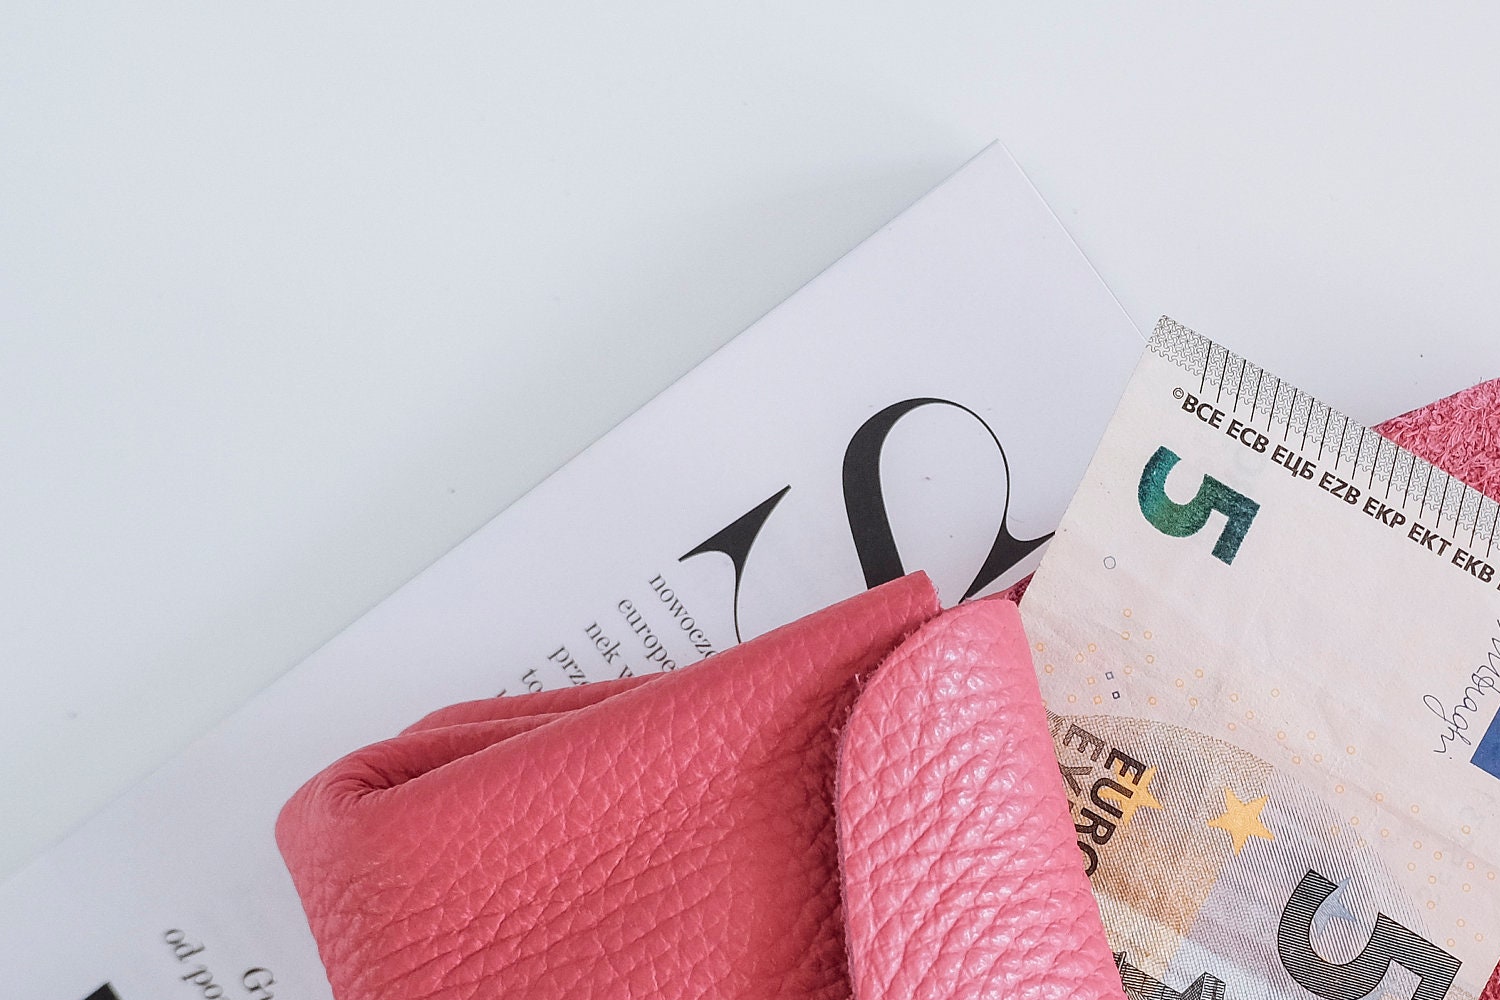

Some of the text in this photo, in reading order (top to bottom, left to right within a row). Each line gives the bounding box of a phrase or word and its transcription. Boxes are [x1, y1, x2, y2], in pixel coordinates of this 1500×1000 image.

[1138, 445, 1261, 564] 5
[1226, 419, 1269, 453] ECB
[1318, 472, 1361, 505] EZB
[1362, 497, 1406, 529] EKP
[1451, 547, 1495, 583] EKB
[585, 621, 621, 664] nek
[165, 928, 205, 961] od
